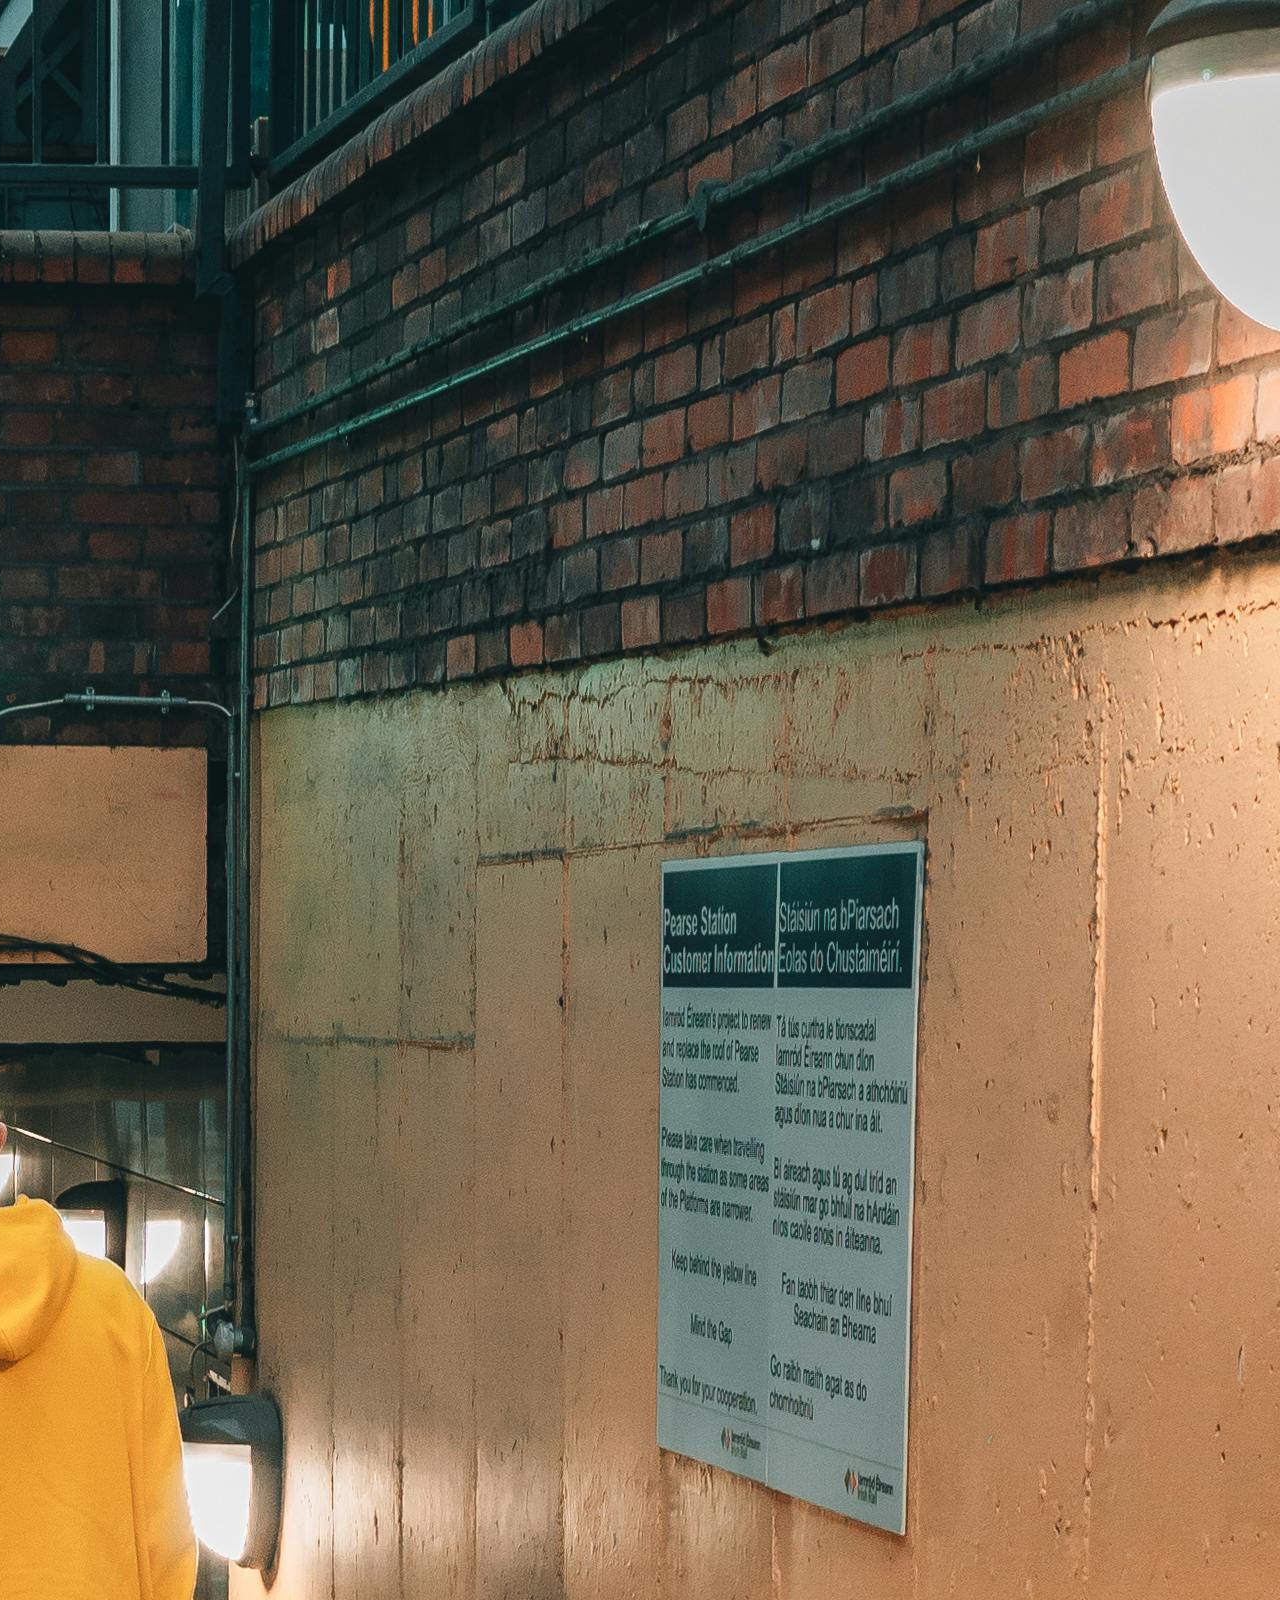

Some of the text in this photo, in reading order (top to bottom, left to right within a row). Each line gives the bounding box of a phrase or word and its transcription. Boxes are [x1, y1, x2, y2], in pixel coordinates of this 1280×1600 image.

[664, 906, 736, 936] Pearse Station
[780, 896, 899, 932] Stáisiún na bPiarsach
[664, 942, 774, 973] Customer Information
[779, 940, 902, 973] Eolas do Chustaiméirí.
[717, 1008, 740, 1034] project
[742, 1010, 748, 1030] to
[750, 1013, 771, 1031] renew
[777, 1015, 786, 1037] Tá
[789, 1016, 799, 1038] tús
[827, 1017, 833, 1039] le
[663, 1038, 759, 1063] and replace the roof of Pearse
[776, 1040, 874, 1072] Iarnród Éireann chun díon
[663, 1066, 683, 1088] Station
[686, 1067, 697, 1089] has
[776, 1072, 804, 1096] Stáisiún
[807, 1079, 816, 1097] na
[818, 1075, 856, 1100] bPiarsach
[859, 1084, 863, 1101] a
[775, 1103, 882, 1133] agus díon nua a chur ina áit.
[662, 1127, 683, 1149] Please
[684, 1129, 697, 1150] take
[699, 1137, 713, 1152] care
[714, 1134, 731, 1155] when
[661, 1158, 769, 1192] through the station as some areas
[784, 1159, 810, 1184] aireach
[812, 1167, 830, 1191] agus
[833, 1165, 840, 1187] tú
[842, 1172, 852, 1195] ag
[855, 1168, 867, 1191] dul
[870, 1170, 883, 1193] tríd
[886, 1177, 896, 1195] an
[661, 1187, 667, 1206] of
[669, 1188, 678, 1209] the
[710, 1200, 720, 1216] are
[803, 1196, 817, 1214] mar
[819, 1198, 828, 1220] go
[831, 1195, 852, 1219] bhfuil
[854, 1203, 864, 1221] na
[773, 1214, 788, 1237] níos
[790, 1220, 811, 1242] caoile
[814, 1223, 833, 1246] anois
[836, 1224, 843, 1248] in
[672, 1249, 757, 1286] Keep behind the yellow line
[782, 1272, 795, 1297] Fan
[798, 1277, 818, 1300] taobh
[820, 1280, 837, 1305] thiar
[839, 1285, 853, 1309] den
[874, 1291, 893, 1316] bhuí
[691, 1313, 732, 1349] Mind the Gap
[794, 1303, 876, 1344] Seachain an Bhearna
[659, 1365, 678, 1388] Thank
[680, 1376, 690, 1396] you
[692, 1375, 701, 1396] for
[702, 1384, 716, 1403] your
[770, 1354, 867, 1401] Go raibh maith agat as do
